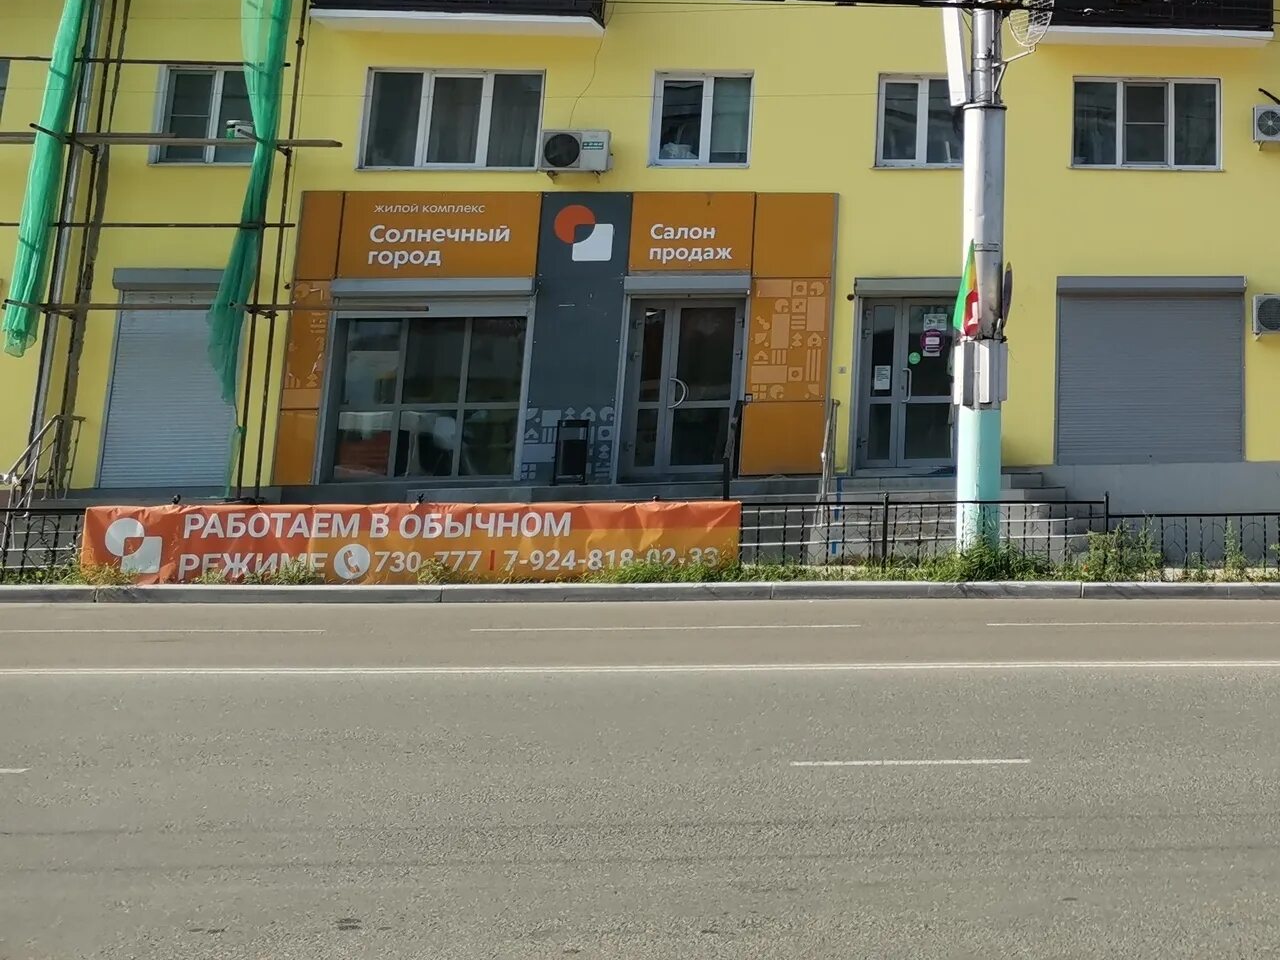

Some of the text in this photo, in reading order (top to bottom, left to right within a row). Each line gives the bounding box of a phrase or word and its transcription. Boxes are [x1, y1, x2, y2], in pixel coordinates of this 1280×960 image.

[374, 204, 486, 213] жилой комплекс
[369, 225, 511, 243] Солнечный
[650, 223, 716, 240] Салон
[368, 250, 441, 269] город
[649, 247, 733, 264] продаж
[183, 512, 571, 539] РАБОТАЕМ В ОБЫЧНОМ
